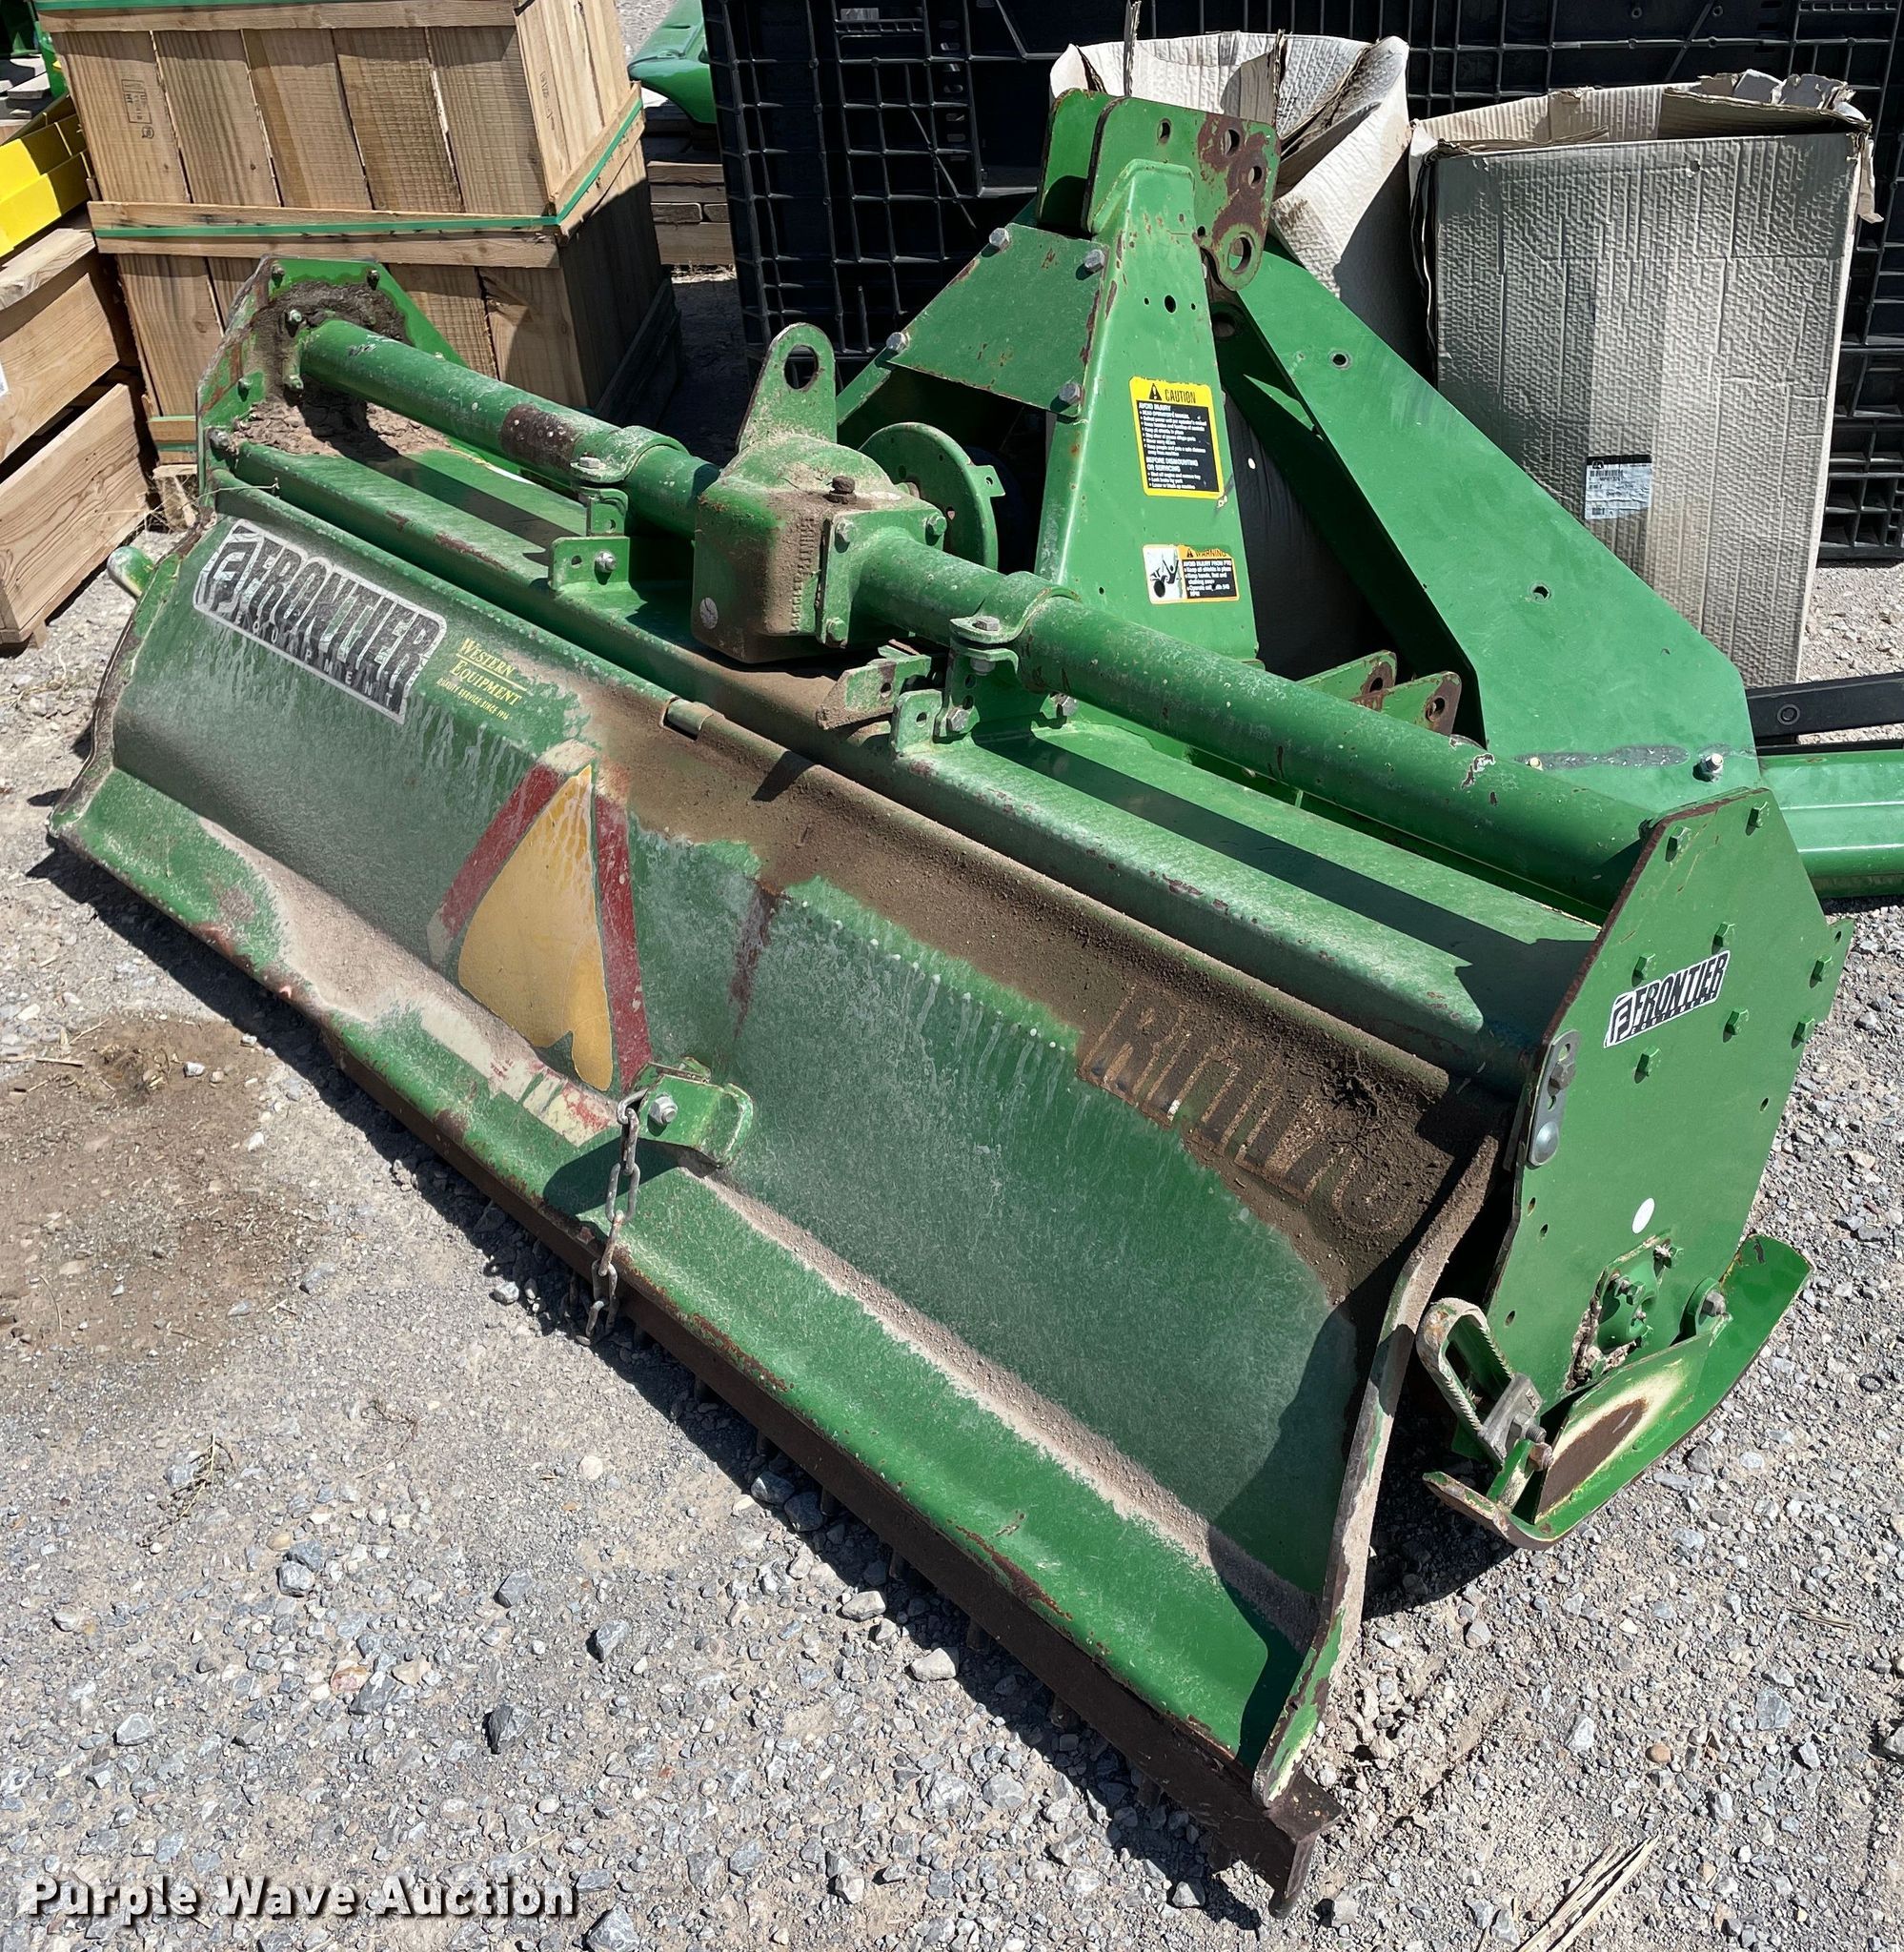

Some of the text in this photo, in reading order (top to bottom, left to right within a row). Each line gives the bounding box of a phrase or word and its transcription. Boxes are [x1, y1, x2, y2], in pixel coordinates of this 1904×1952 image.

[1165, 389, 1196, 403] CAUTION
[238, 534, 442, 696] FRONTIER
[458, 638, 516, 677] WESTERN
[450, 660, 522, 706] EQUIPMENT
[457, 688, 482, 705] SERVICE
[479, 700, 499, 715] SINCE
[1631, 952, 1729, 1031] FRONTIER
